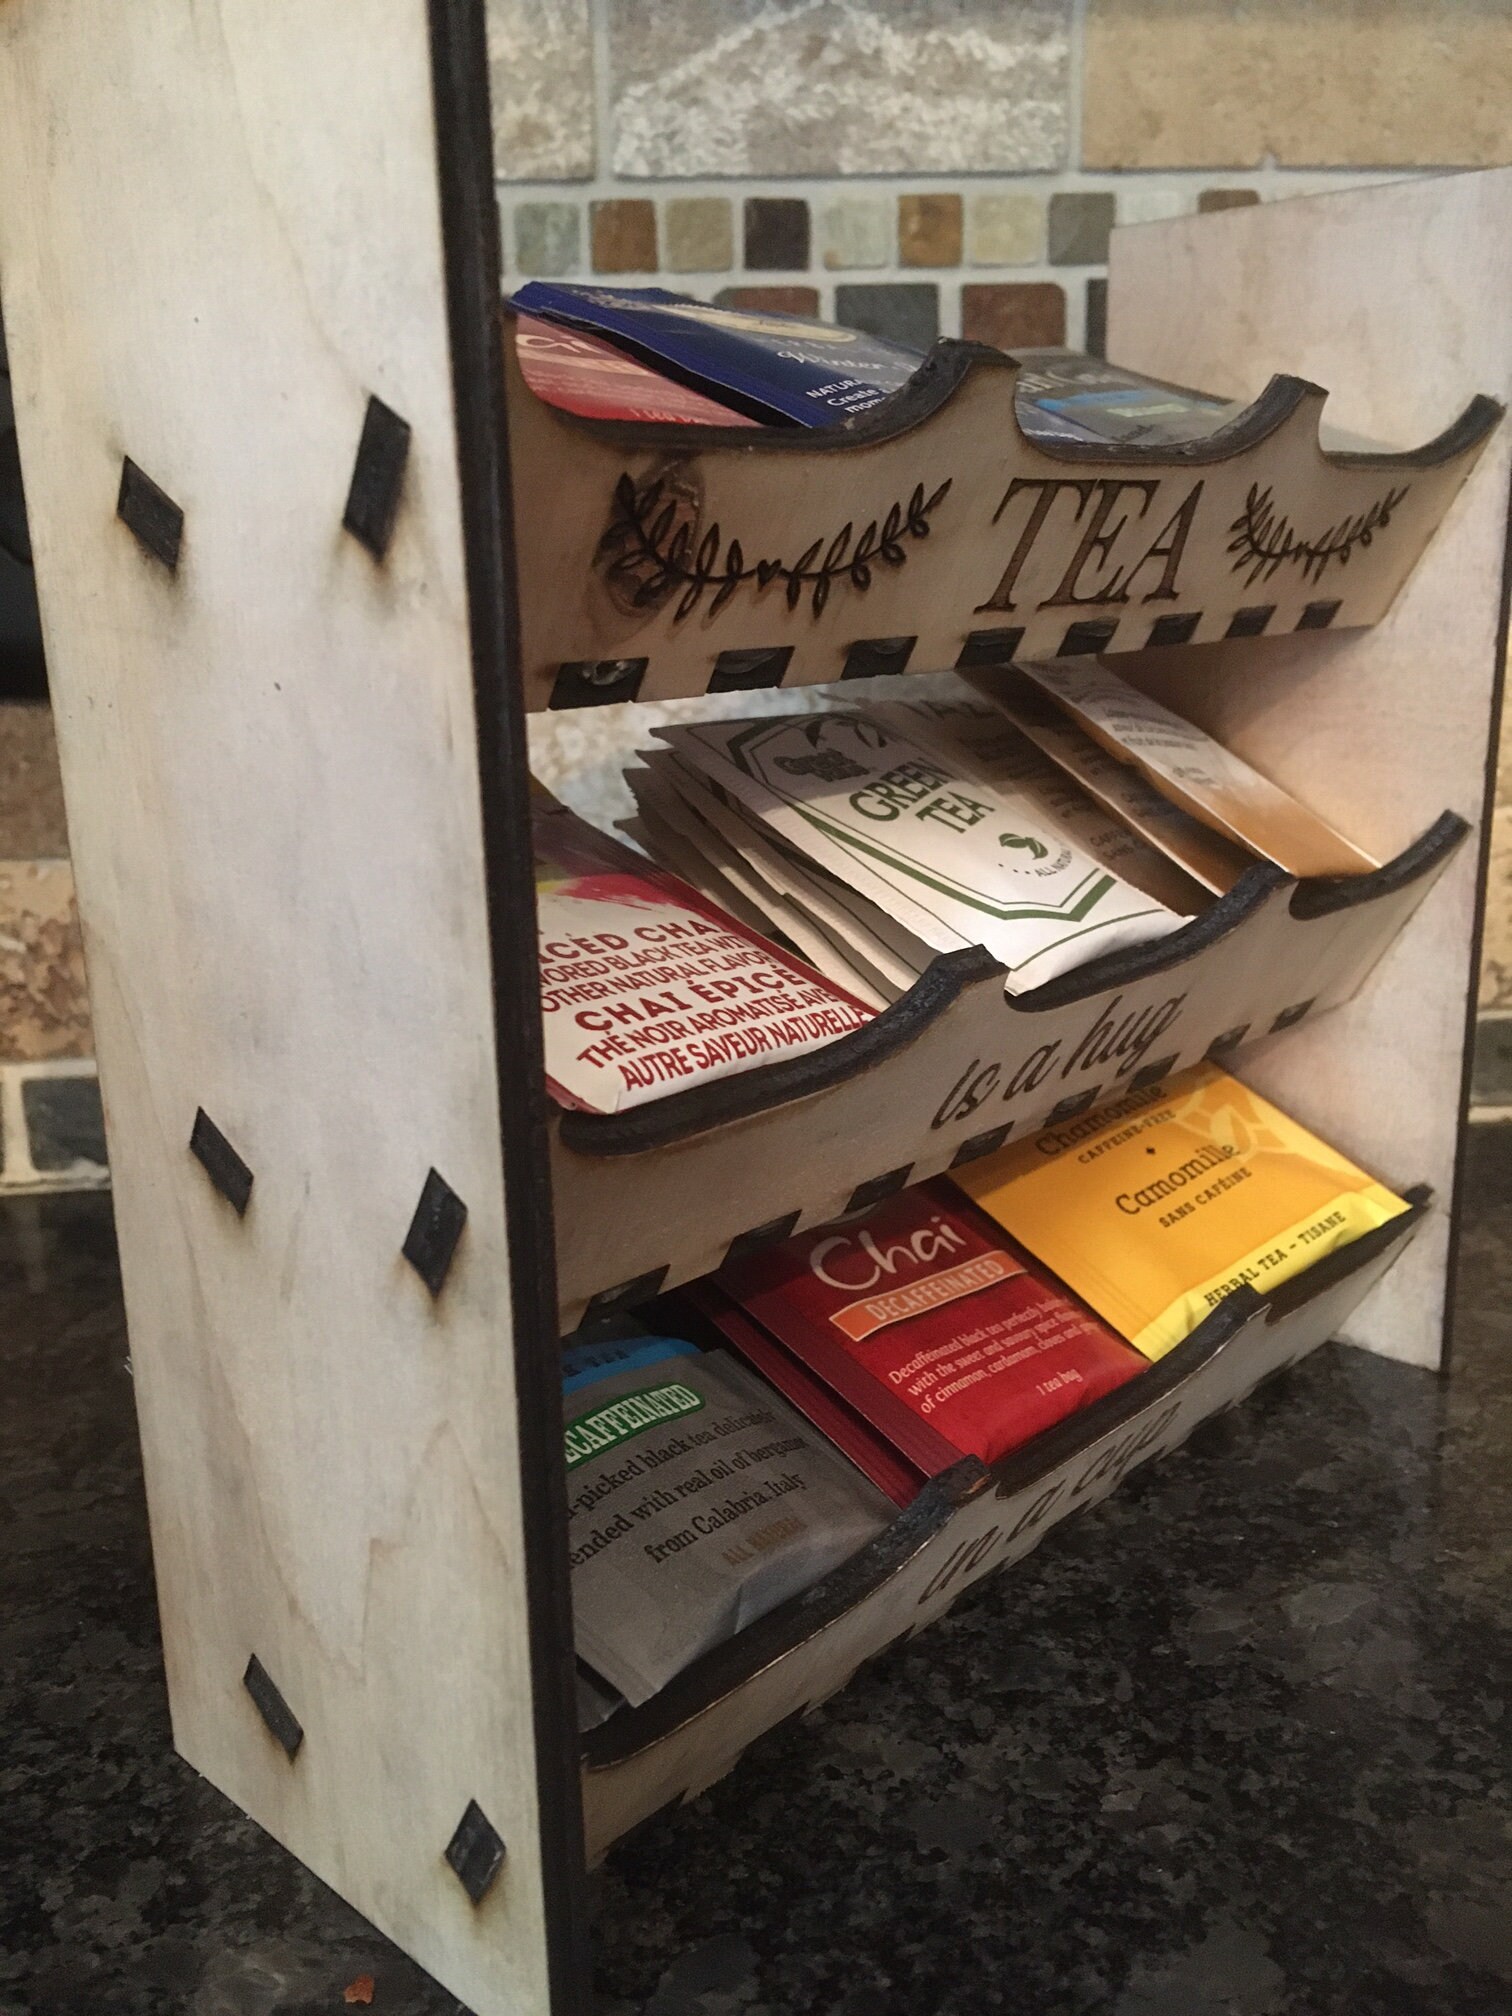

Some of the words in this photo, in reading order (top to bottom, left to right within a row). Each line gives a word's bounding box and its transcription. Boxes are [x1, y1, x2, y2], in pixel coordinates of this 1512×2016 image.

[806, 378, 864, 399] NATURA
[827, 388, 880, 406] Create
[844, 397, 887, 414] mom
[973, 477, 1204, 614] TEA
[849, 757, 957, 822] GREEN
[915, 791, 996, 834] TEA
[602, 945, 683, 971] BLACK
[668, 940, 719, 957] TEA
[704, 935, 752, 950] WIT
[634, 919, 721, 943] CHA
[541, 981, 618, 1012] OTHER
[605, 961, 711, 993] NATURAL
[575, 991, 693, 1031] CHAI
[576, 1030, 637, 1069] THÉ
[624, 1020, 696, 1049] NOIR
[797, 987, 839, 1009] AVE
[618, 1047, 694, 1092] AUTRE
[686, 1026, 773, 1070] SAVEUR
[930, 1058, 1002, 1130] is
[1003, 1039, 1062, 1101] a
[1061, 993, 1189, 1080] hug
[1077, 1108, 1177, 1165] CAFFEINE-FREE
[1114, 1144, 1241, 1216] Camomille
[1158, 1201, 1197, 1228] SANS
[810, 1216, 967, 1291] Chai
[1203, 1267, 1260, 1308] HERBAL
[1257, 1248, 1289, 1271] TEA
[1297, 1210, 1347, 1245] TISANE
[865, 1258, 1005, 1322] DECAFFEINATED
[889, 1337, 963, 1385] Decaffeinated
[957, 1327, 990, 1348] black
[908, 1370, 939, 1397] with
[935, 1360, 958, 1379] the
[954, 1349, 986, 1370] sweet
[1042, 1378, 1063, 1394] tea
[1056, 1367, 1084, 1385] bag
[921, 1393, 937, 1415] of
[935, 1366, 993, 1403] cinnamon,
[564, 1384, 701, 1463] ECAFFEINATED
[636, 1438, 695, 1469] black
[688, 1429, 718, 1447] tea
[569, 1513, 635, 1568] ended
[629, 1489, 679, 1521] with
[673, 1469, 713, 1498] real
[710, 1459, 736, 1480] oil
[731, 1450, 751, 1471] of
[644, 1528, 699, 1564] from
